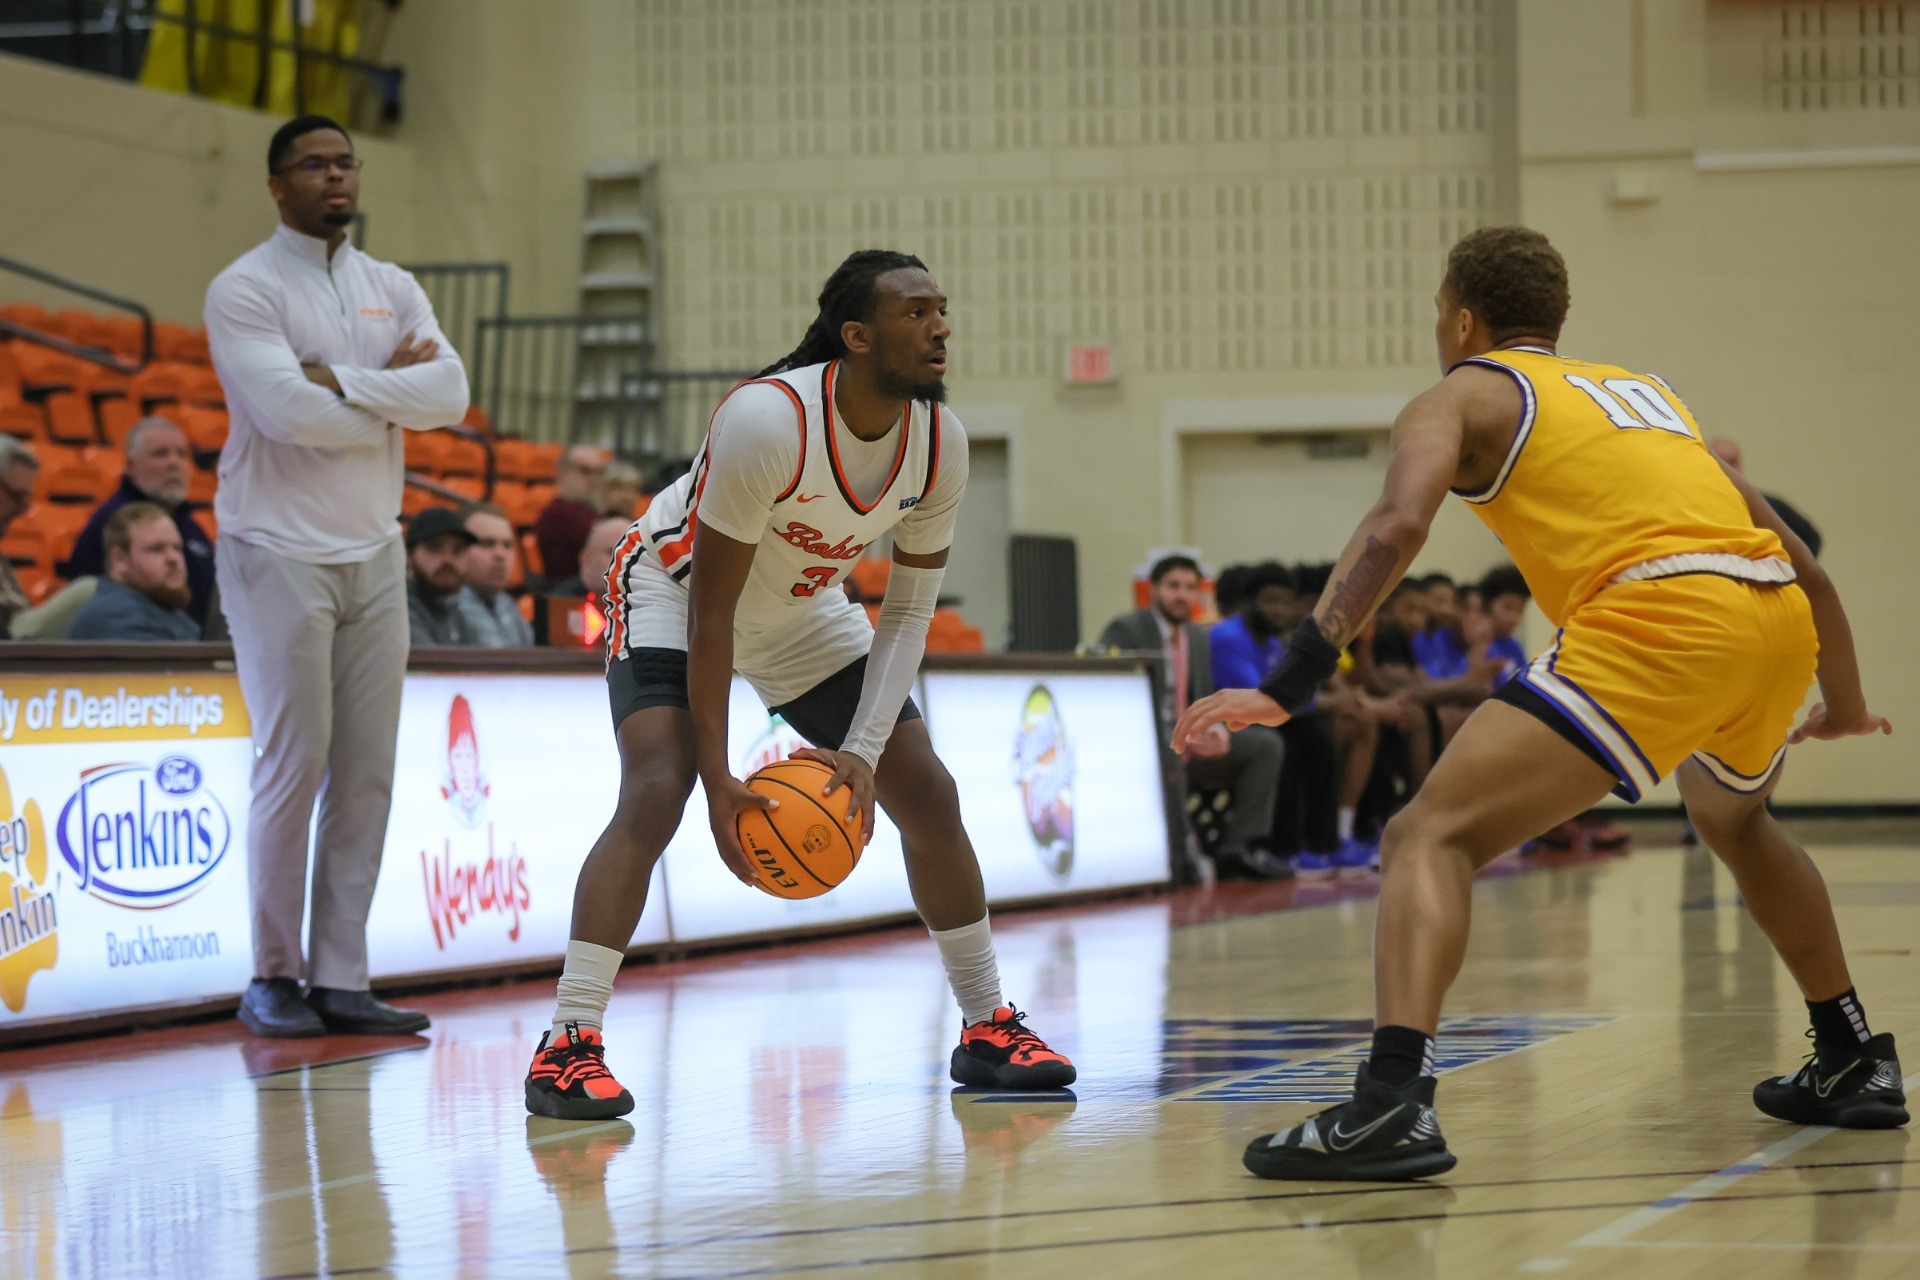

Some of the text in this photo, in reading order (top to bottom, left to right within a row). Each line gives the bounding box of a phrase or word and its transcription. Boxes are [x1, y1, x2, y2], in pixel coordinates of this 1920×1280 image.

[1563, 374, 1697, 440] 10
[790, 566, 839, 597] 3
[25, 687, 58, 730] of
[62, 687, 223, 734] Dealerships
[160, 759, 196, 792] Ford
[77, 779, 213, 890] Jenkins
[753, 849, 799, 889] EVO
[105, 924, 221, 969] Buckhannon
